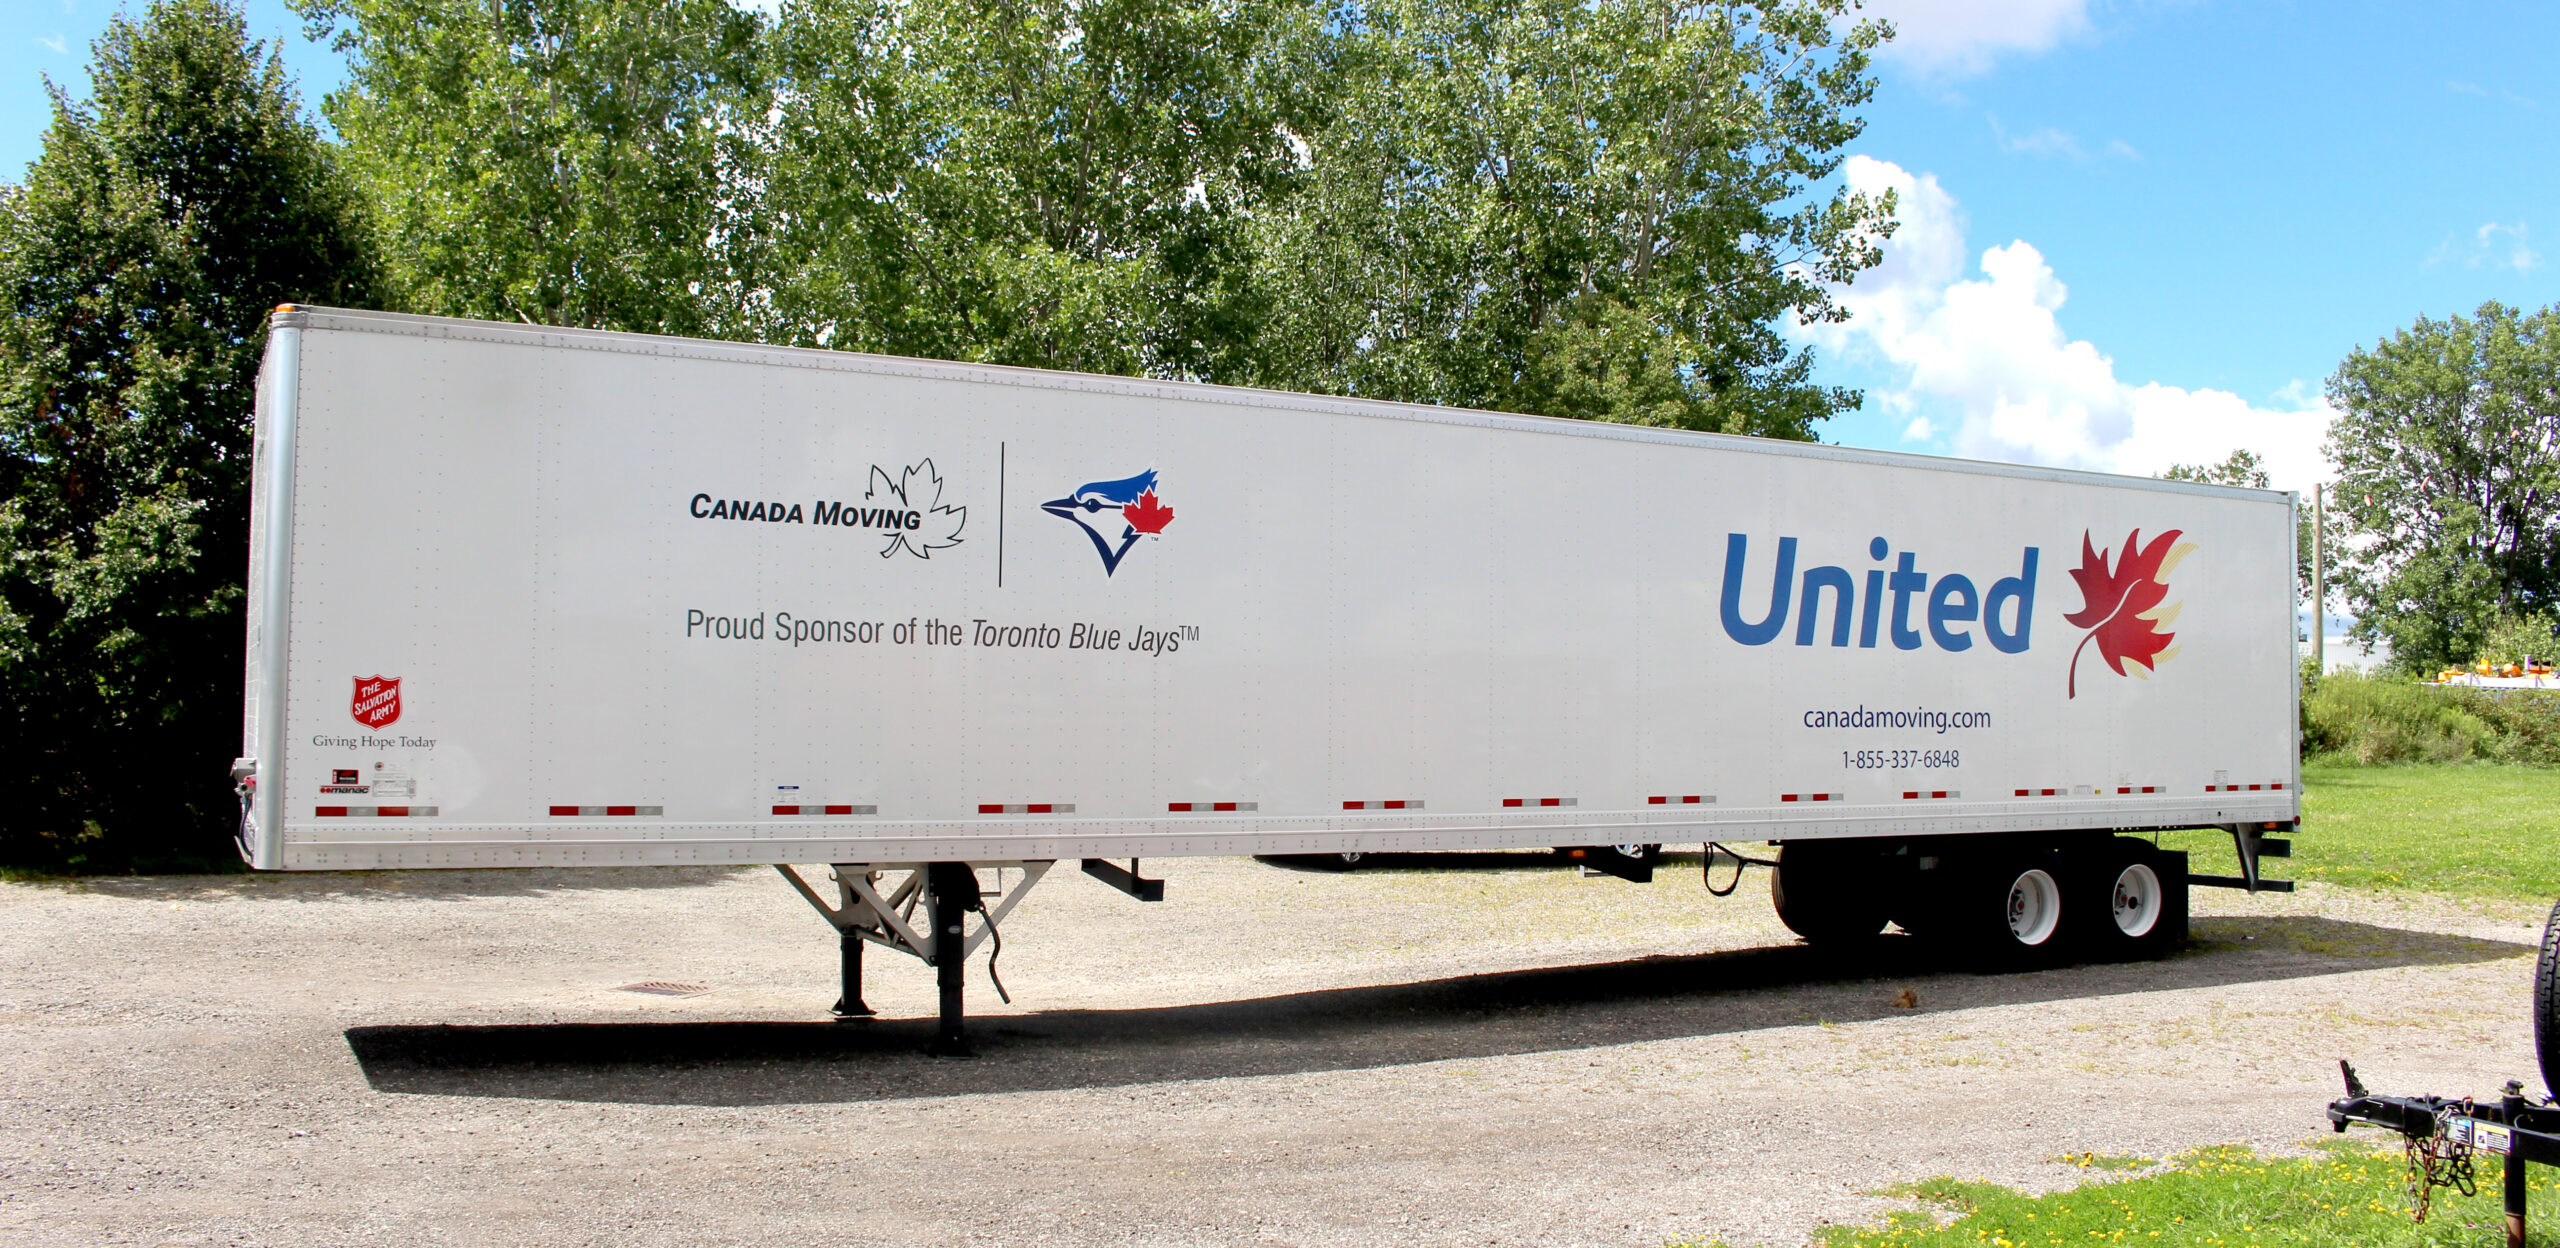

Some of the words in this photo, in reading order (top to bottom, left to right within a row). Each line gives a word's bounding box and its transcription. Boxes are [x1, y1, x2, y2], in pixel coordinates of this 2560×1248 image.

[690, 493, 803, 524] CANADA
[813, 500, 921, 531] MOVING
[1720, 533, 2039, 654] United
[687, 609, 765, 640] Proud
[775, 612, 887, 647] Sponsor
[893, 617, 918, 645] of
[924, 618, 962, 646] the
[972, 619, 1060, 648] Toronto
[1069, 622, 1121, 650] Blue
[354, 685, 397, 716] SALVATION
[361, 681, 381, 698] THE
[369, 701, 396, 723] ARMY
[1803, 705, 1992, 734] canadamoving.com
[313, 735, 357, 750] Giving
[361, 735, 396, 750] Hope
[399, 736, 437, 751] Today
[1842, 750, 1960, 769] 1-855-337-6848
